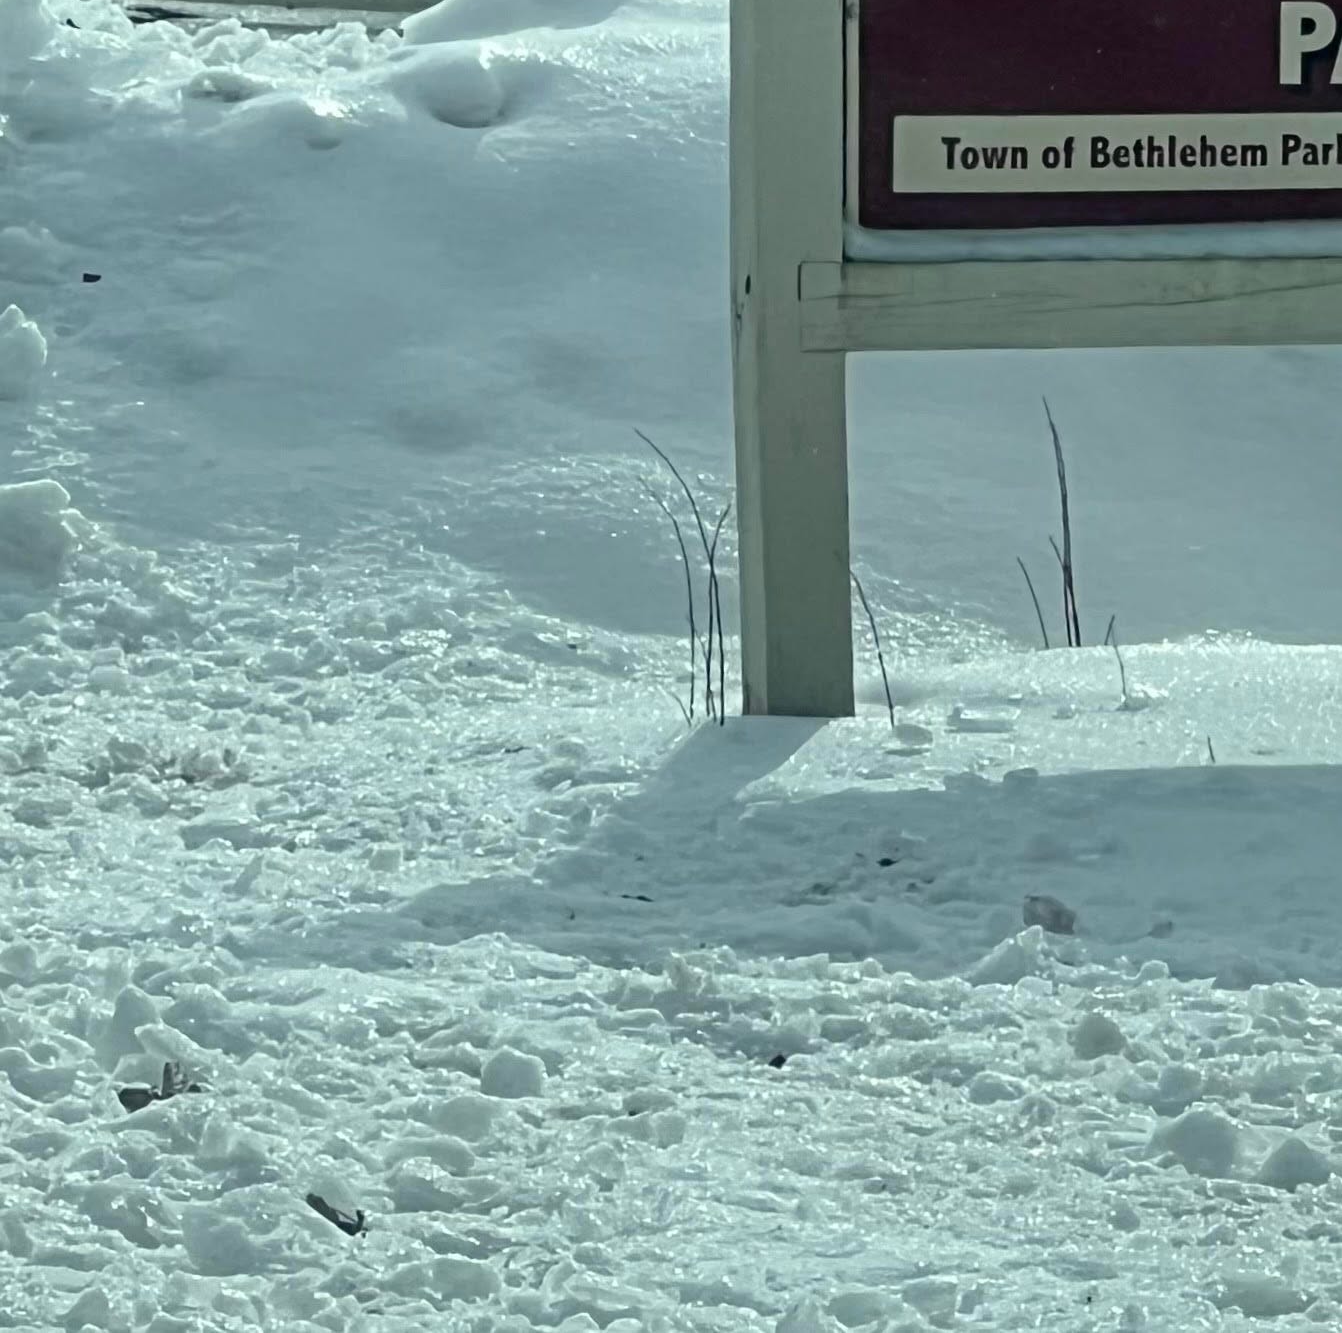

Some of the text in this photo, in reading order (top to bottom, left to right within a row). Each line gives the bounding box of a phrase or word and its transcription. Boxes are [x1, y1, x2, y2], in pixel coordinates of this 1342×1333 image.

[941, 137, 1027, 169] Town
[1042, 137, 1074, 168] of
[1091, 135, 1267, 168] Bethlehem
